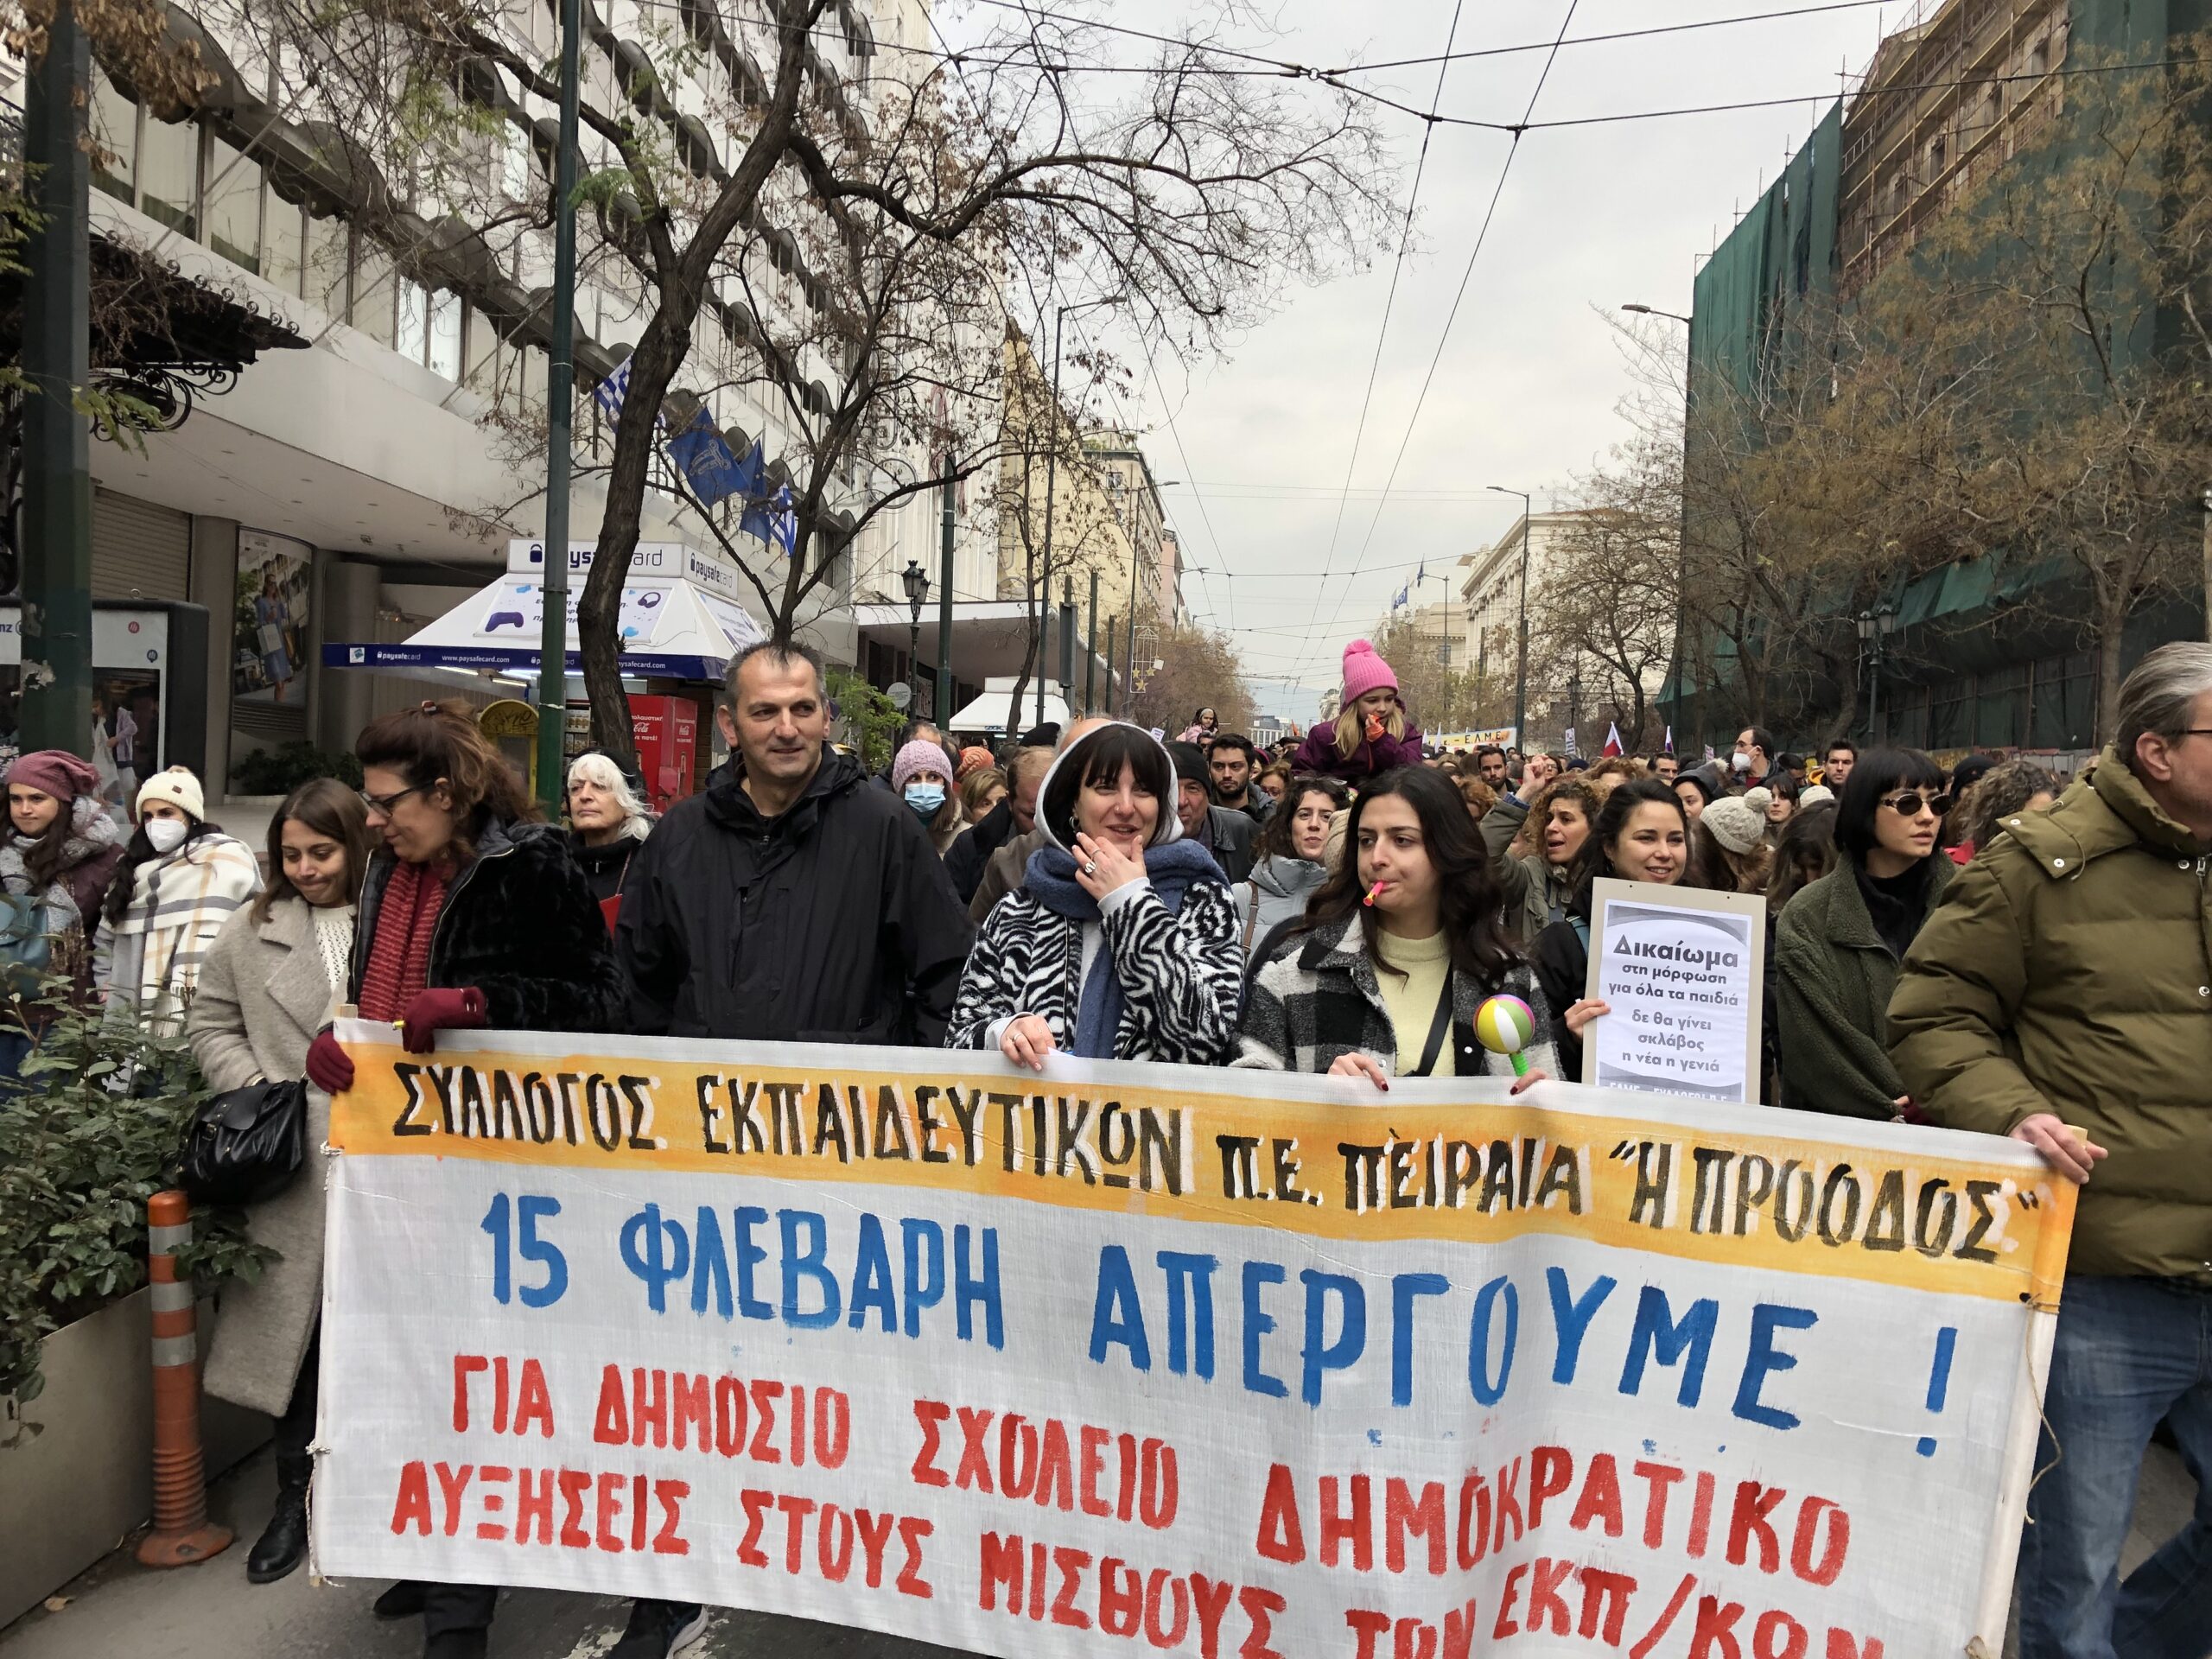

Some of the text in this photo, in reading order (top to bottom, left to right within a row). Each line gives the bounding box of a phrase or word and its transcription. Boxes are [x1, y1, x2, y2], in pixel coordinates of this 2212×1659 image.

[696, 561, 732, 588] paysafecard
[1613, 934, 1738, 970] Δικαίωμα
[1622, 964, 1726, 984] στη μόρφωση
[1609, 982, 1738, 1006] για όλα τα παιδιά
[1631, 1009, 1712, 1030] δε θα γίνει
[1638, 1032, 1705, 1052] σκλάβος
[1622, 1052, 1719, 1072] η νέα η γενιά
[393, 1062, 657, 1151] ΣΥΛΛΟΓΟΣ
[697, 1074, 1184, 1196] ΕΚΠΑΙΔΕΥΤΙΚΩΝ
[1216, 1134, 1319, 1206] Π.Ε.
[1338, 1136, 1583, 1217] ΠΕΙΡΑΙΑ
[481, 1192, 569, 1309] 15
[620, 1202, 1005, 1352] ΦΛΕΒΑΡΗ
[1089, 1244, 1819, 1432] ΑΠΕΡΓΟΥΜΕ
[453, 1355, 1851, 1586] ΓΙΑ ΔΗΜΟΣΙΟ ΣΧΟΛΕΙΟ ΔΗΜΟΚΡΑΤΙΚΟ
[391, 1459, 690, 1556] ΑΥΞΗΣΕΙΣ
[737, 1488, 934, 1599] ΣΤΟΥΣ
[979, 1530, 1287, 1659] ΜΙΣΘΟΥΣ
